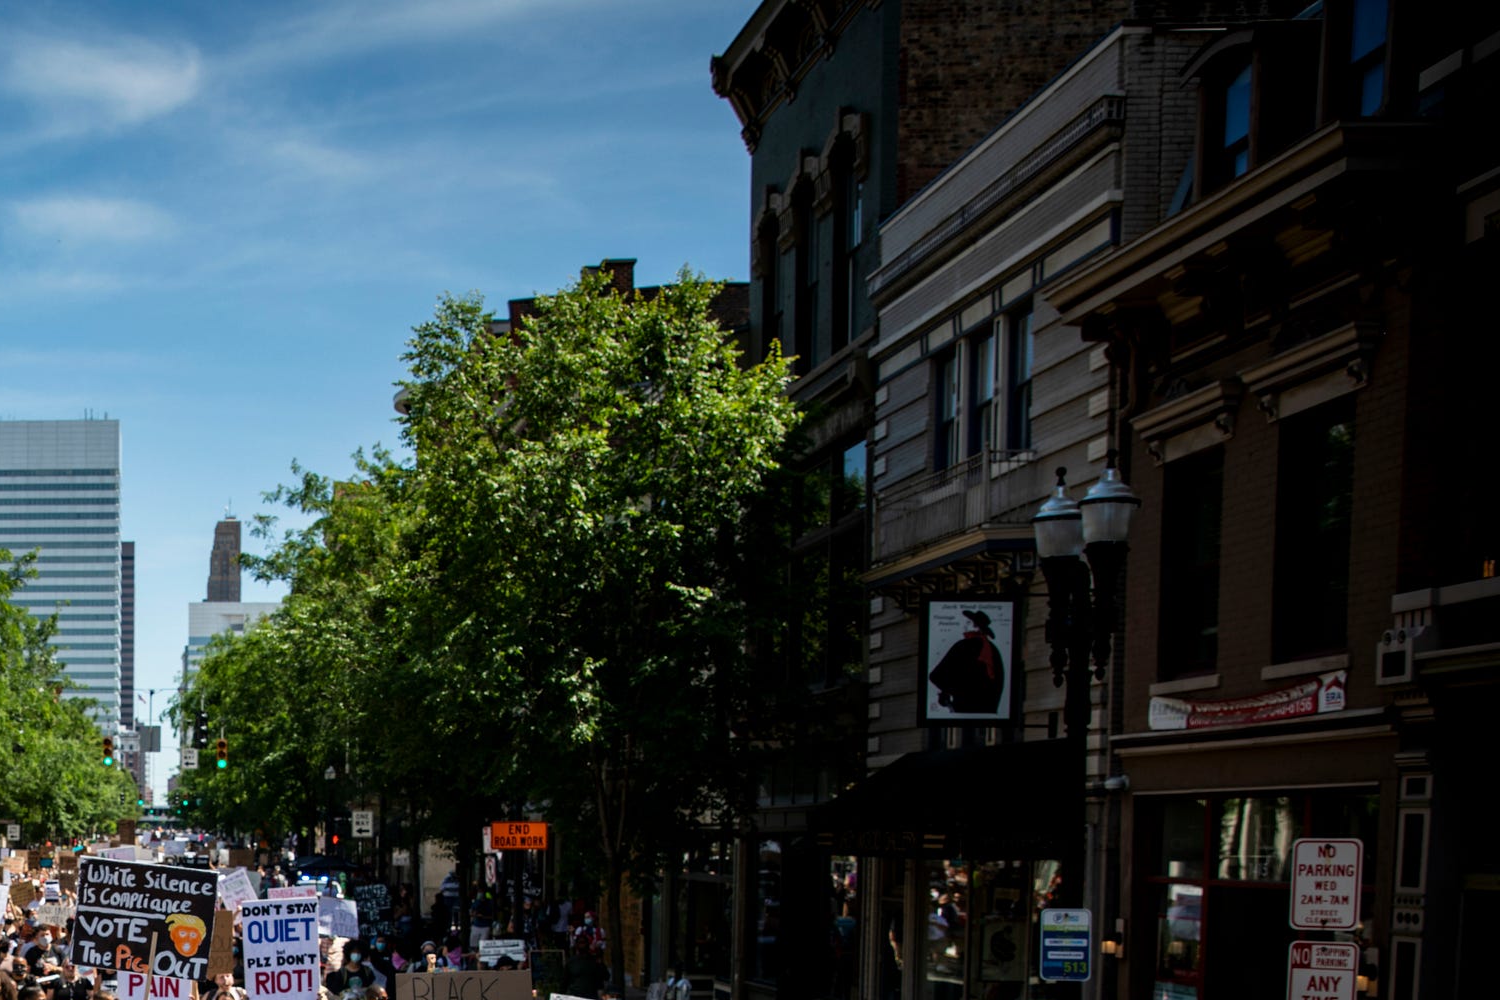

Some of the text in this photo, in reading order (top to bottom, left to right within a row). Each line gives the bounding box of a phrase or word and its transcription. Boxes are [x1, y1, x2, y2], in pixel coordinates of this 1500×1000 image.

[508, 824, 530, 835] END
[494, 836, 544, 847] ROAD WORK
[1317, 846, 1336, 859] NO
[1298, 864, 1354, 878] PARKING
[1315, 881, 1337, 891] WED
[242, 902, 318, 917] DON'T STAY
[78, 914, 149, 944] VOTE
[246, 918, 315, 944] QUIET
[78, 940, 113, 966] The
[247, 953, 317, 968] PLZ DON'T
[1291, 946, 1311, 966] NO
[1062, 961, 1088, 974] 513
[255, 969, 313, 995] RIOT!
[1306, 976, 1342, 993] ANY
